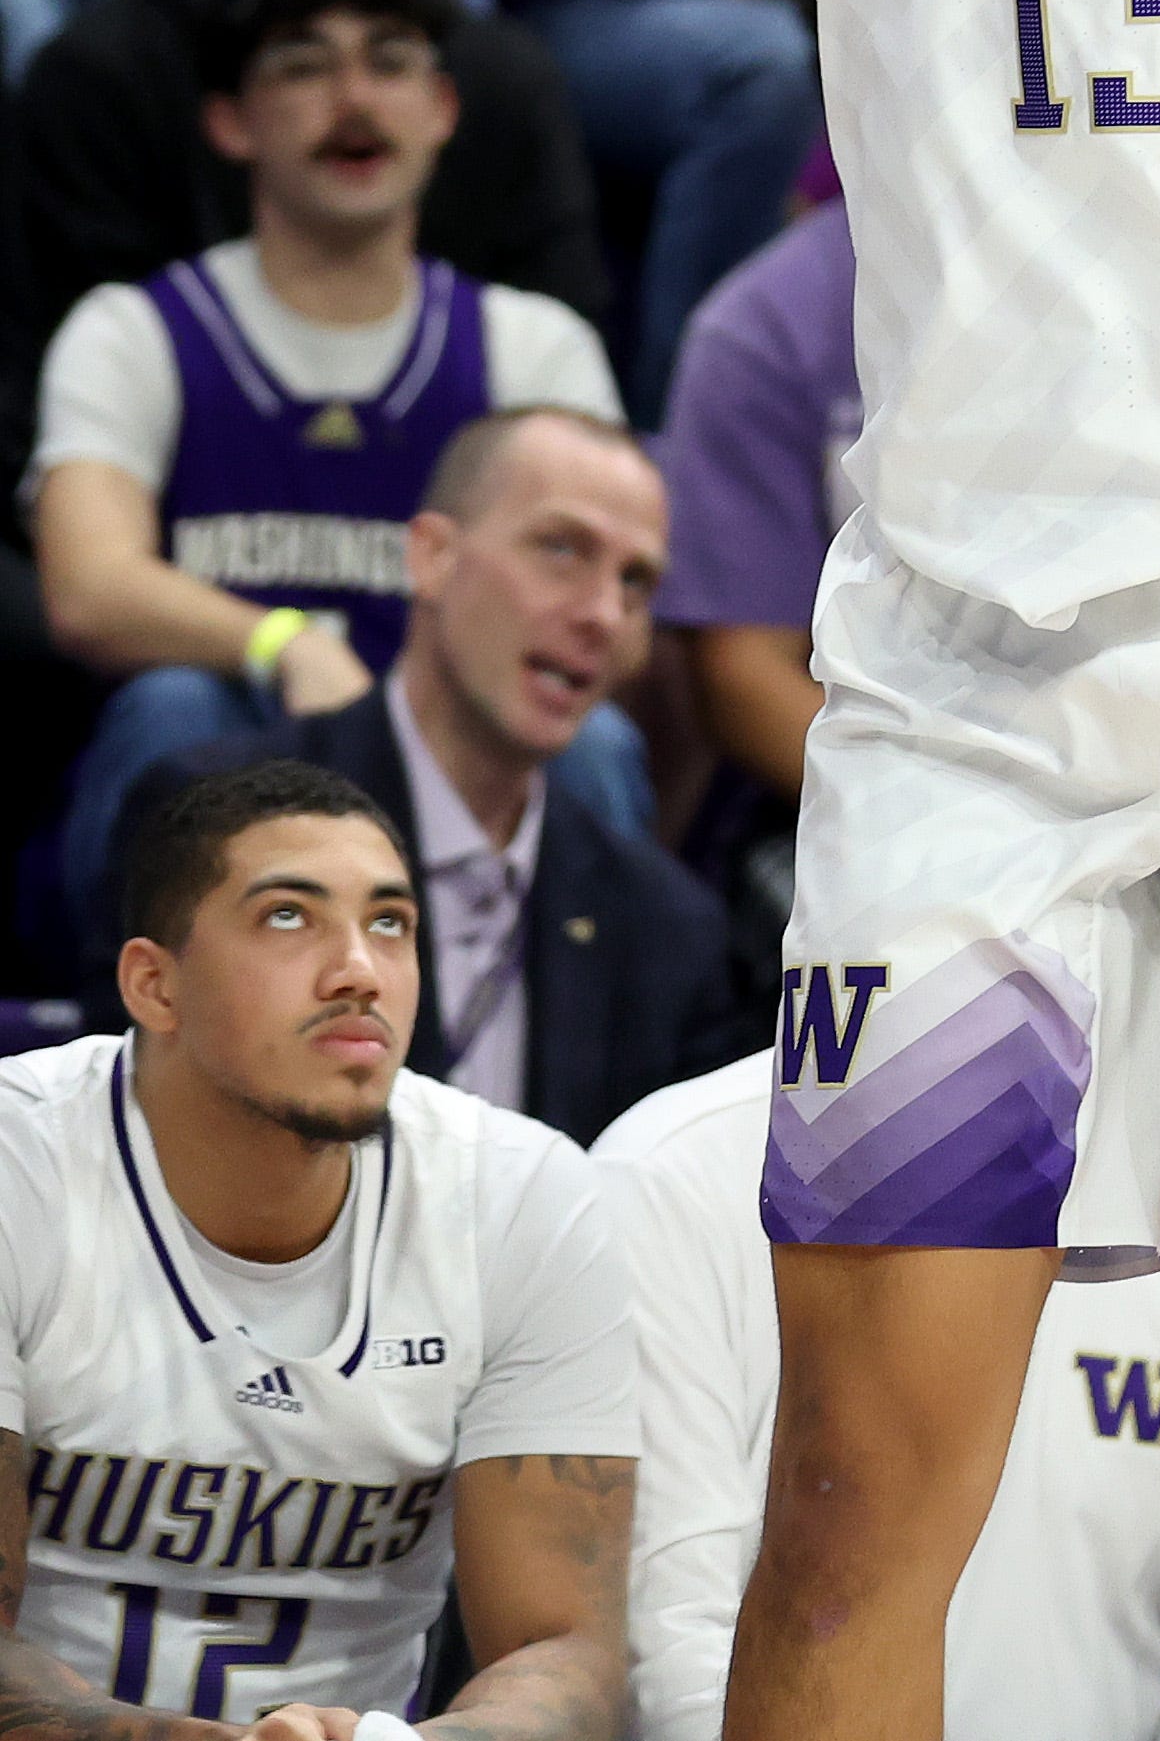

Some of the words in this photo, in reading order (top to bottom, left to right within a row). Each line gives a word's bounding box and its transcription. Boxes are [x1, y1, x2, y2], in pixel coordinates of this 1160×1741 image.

[779, 962, 892, 1091] W
[372, 1337, 446, 1370] B1G
[28, 1445, 444, 1570] HUSKIES
[107, 1581, 311, 1722] 12
